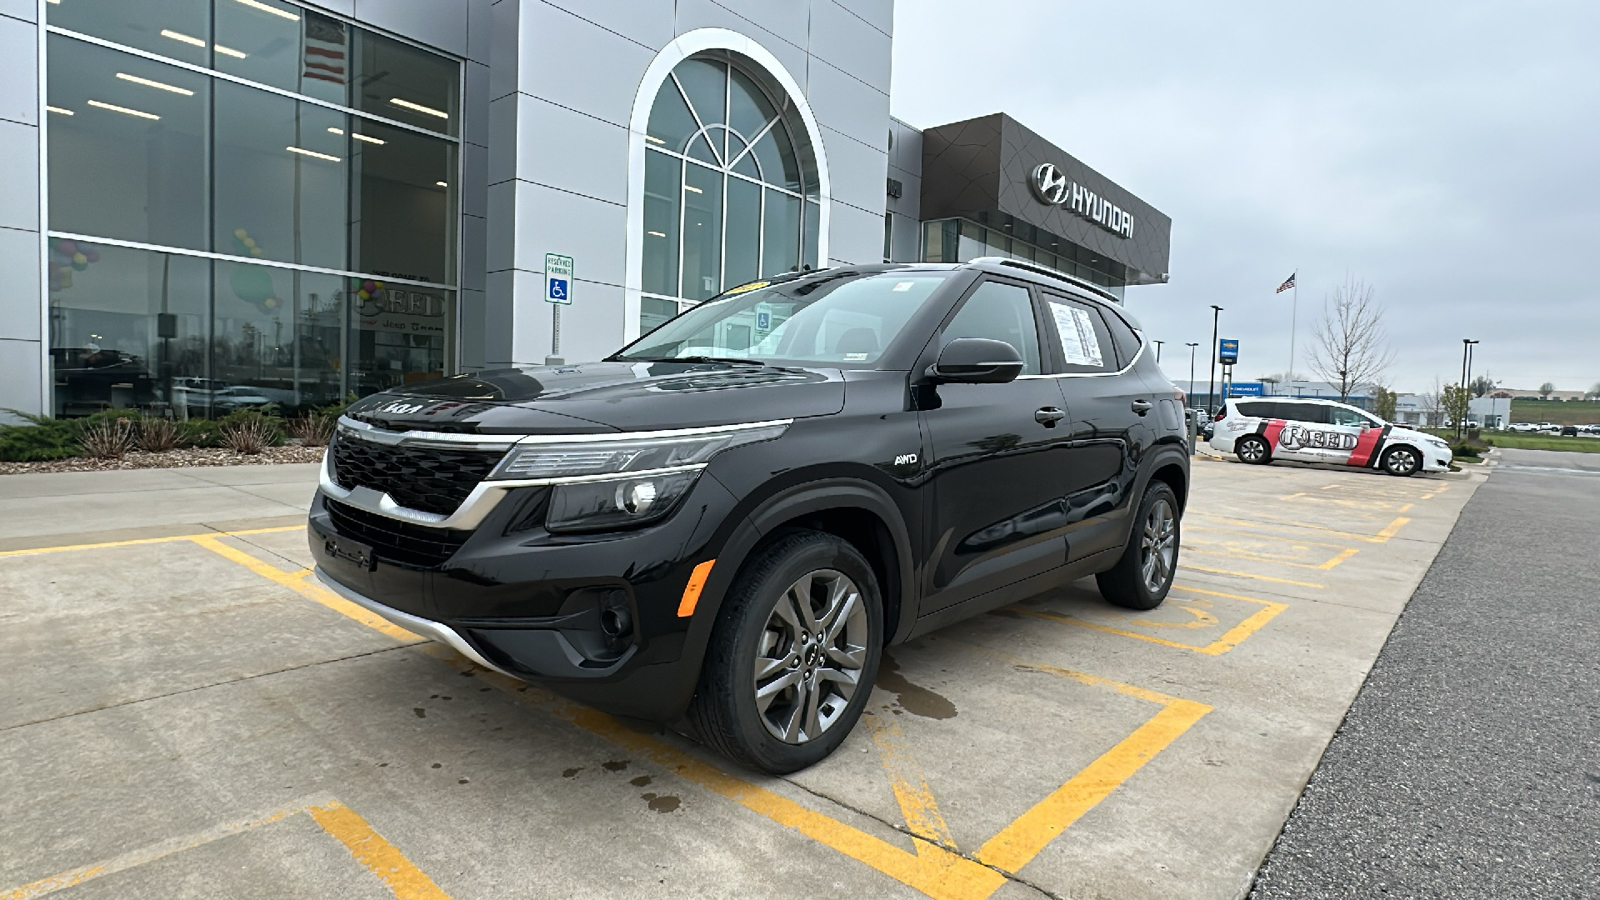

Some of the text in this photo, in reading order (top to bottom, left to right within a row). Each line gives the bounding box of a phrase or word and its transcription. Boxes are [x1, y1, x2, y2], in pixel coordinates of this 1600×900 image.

[1072, 182, 1134, 239] HYUNDAI
[548, 257, 571, 267] RESERVED
[548, 265, 571, 276] PARKING
[1282, 426, 1359, 450] REED
[894, 453, 918, 466] AWD
